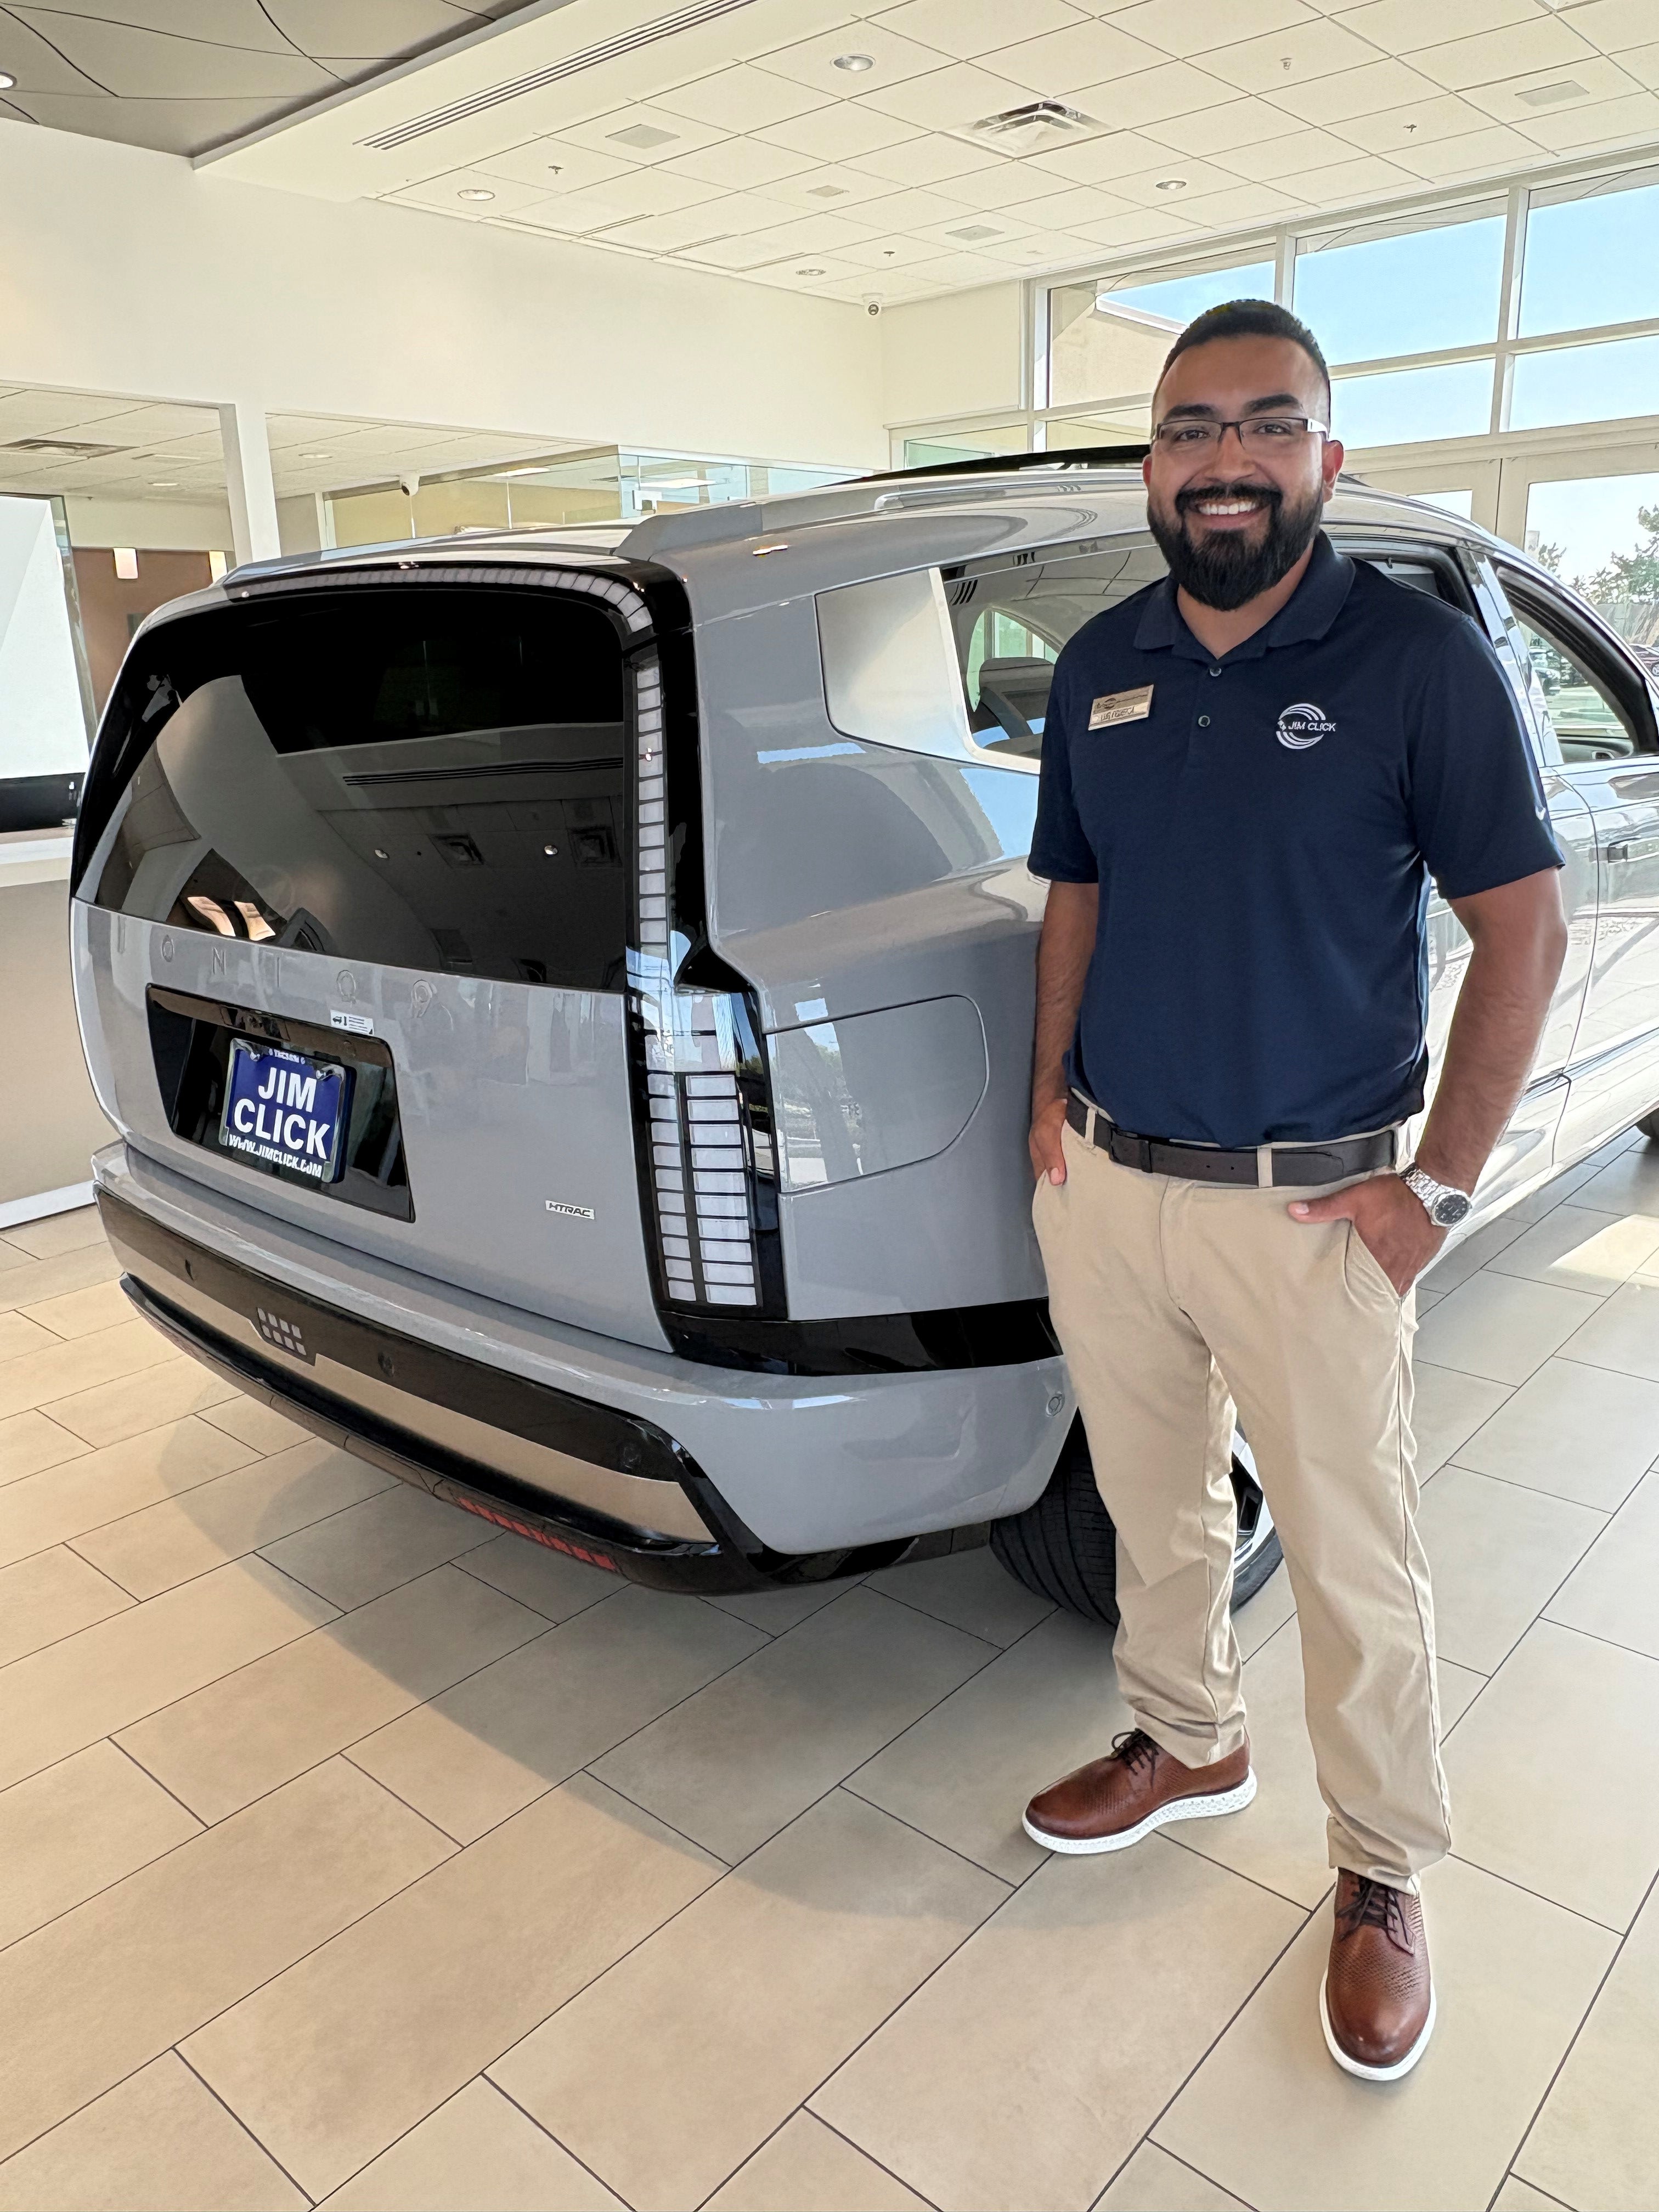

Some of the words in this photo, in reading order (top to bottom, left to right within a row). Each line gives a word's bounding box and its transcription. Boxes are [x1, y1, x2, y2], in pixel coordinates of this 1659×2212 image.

[1288, 721, 1306, 730] JIM
[1307, 722, 1337, 732] CLICK
[258, 1066, 318, 1113] JIM
[233, 1098, 331, 1160] CLICK
[549, 1202, 591, 1217] HTRAC
